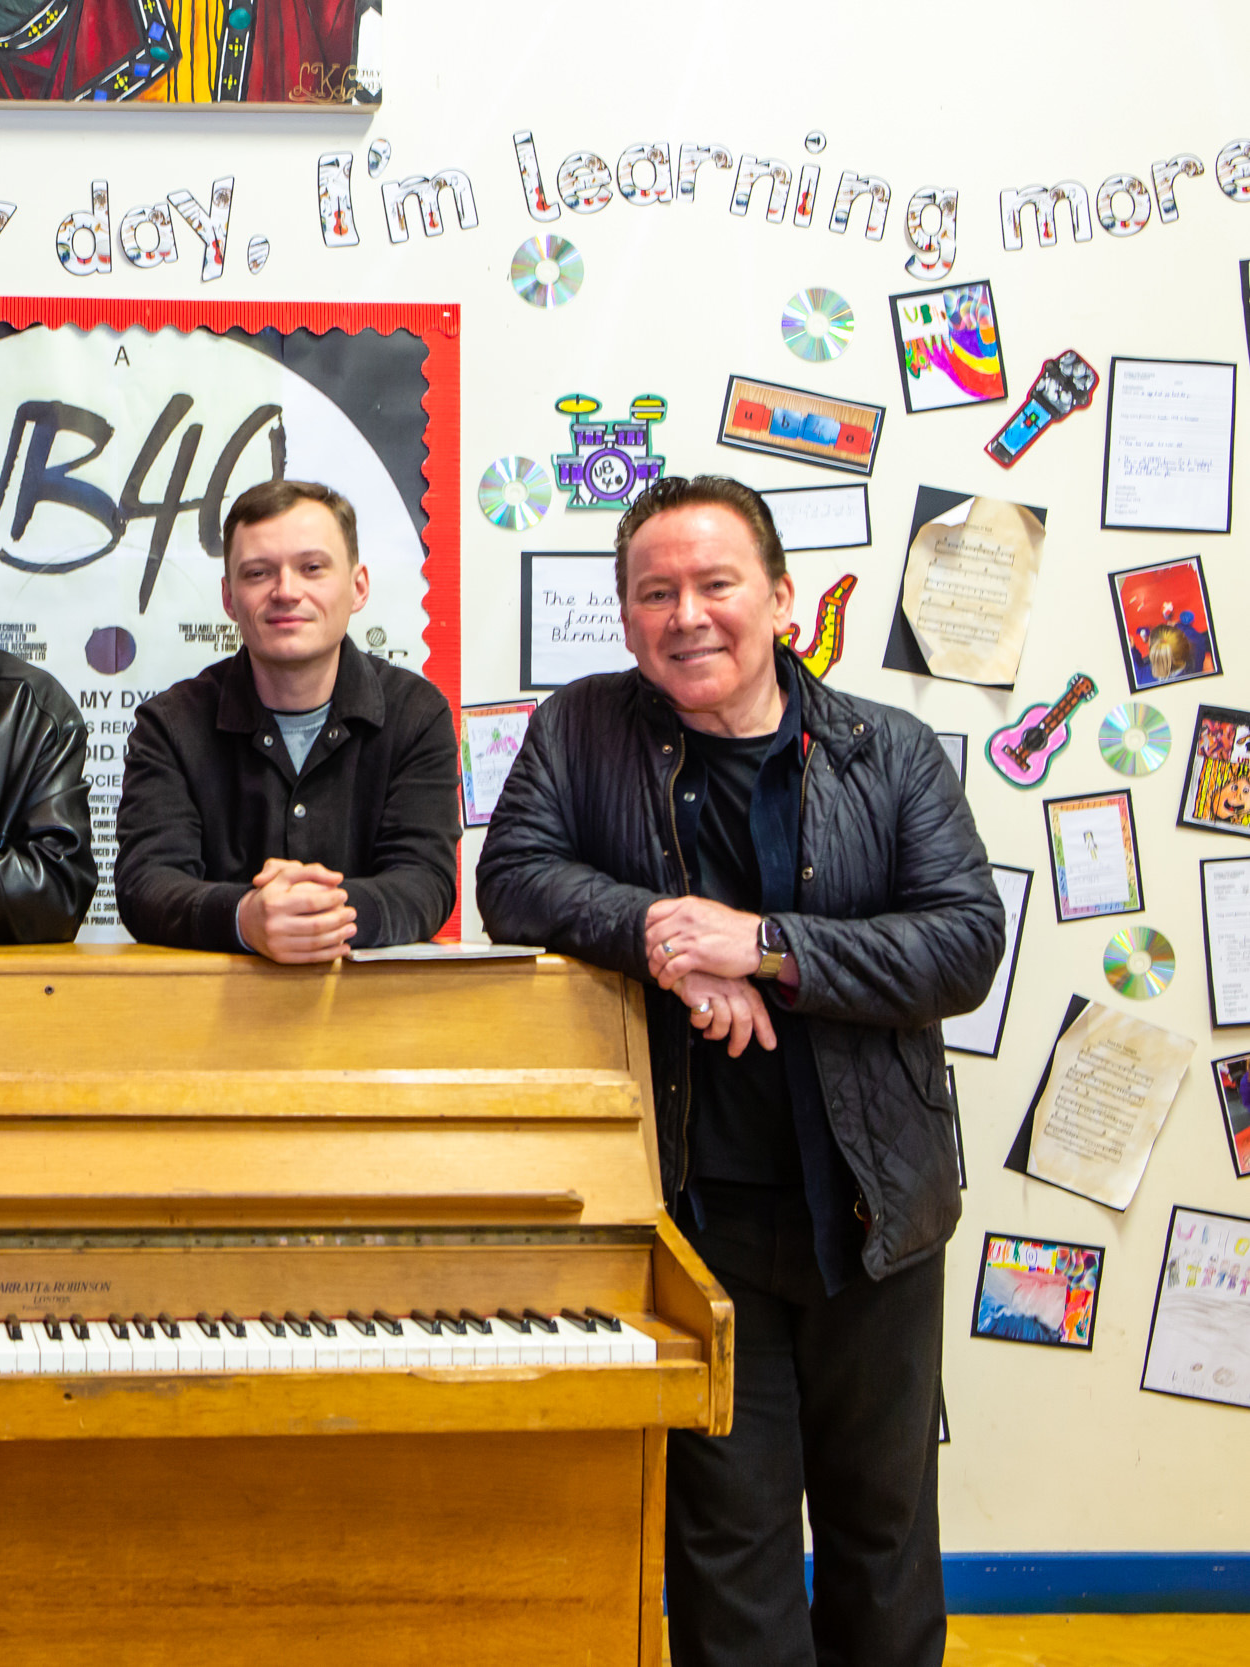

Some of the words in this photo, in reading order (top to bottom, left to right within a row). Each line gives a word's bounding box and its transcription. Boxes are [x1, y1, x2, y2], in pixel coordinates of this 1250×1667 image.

[55, 176, 270, 283] day,
[317, 139, 480, 249] I'm
[511, 129, 959, 281] learning
[999, 138, 1250, 252] more
[114, 346, 130, 367] A
[542, 589, 576, 606] The
[586, 591, 621, 606] ba
[551, 626, 626, 642] Birmin
[80, 690, 112, 709] MY
[101, 721, 135, 734] REM
[84, 774, 123, 787] OCIE
[53, 1280, 111, 1293] ROBINSON
